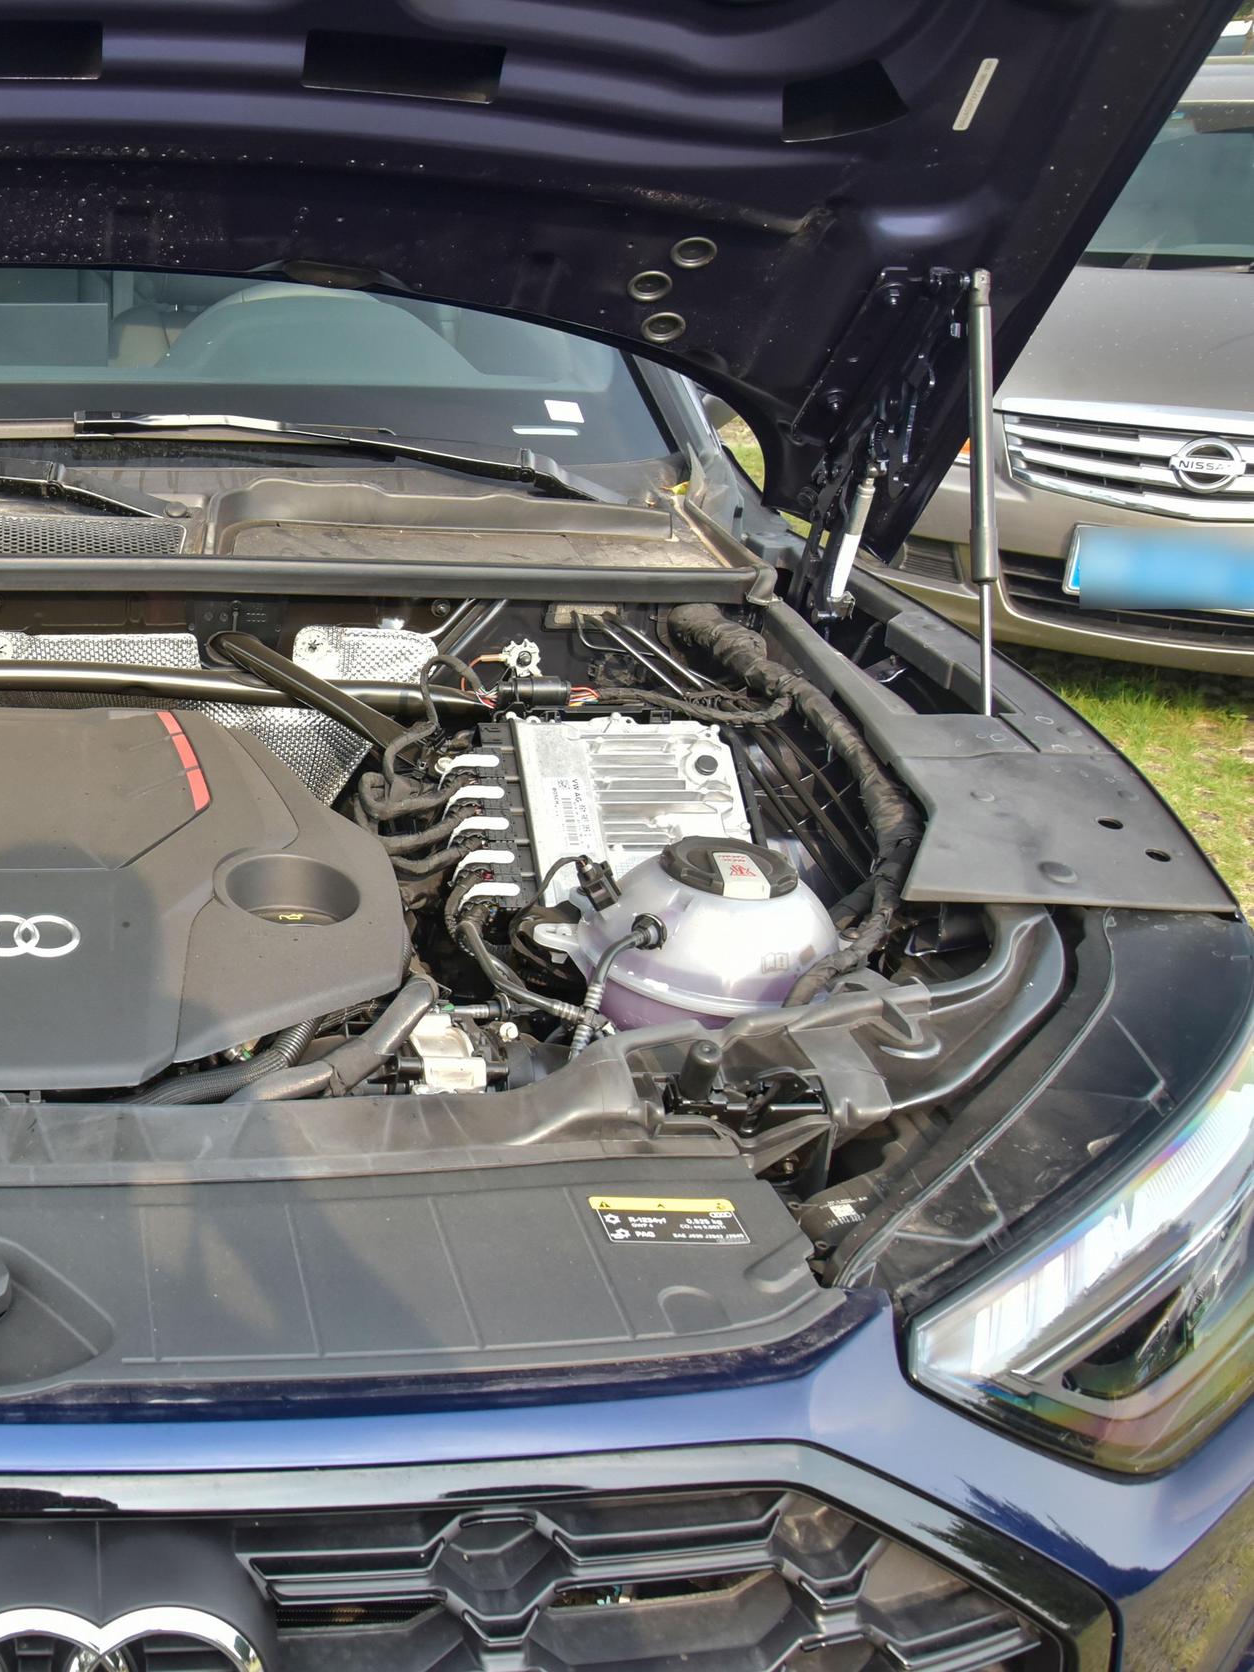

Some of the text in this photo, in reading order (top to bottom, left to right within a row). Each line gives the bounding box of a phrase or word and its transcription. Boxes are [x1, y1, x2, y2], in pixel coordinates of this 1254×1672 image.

[1178, 460, 1233, 471] NISSA
[572, 778, 579, 790] VW
[574, 792, 582, 802] AG
